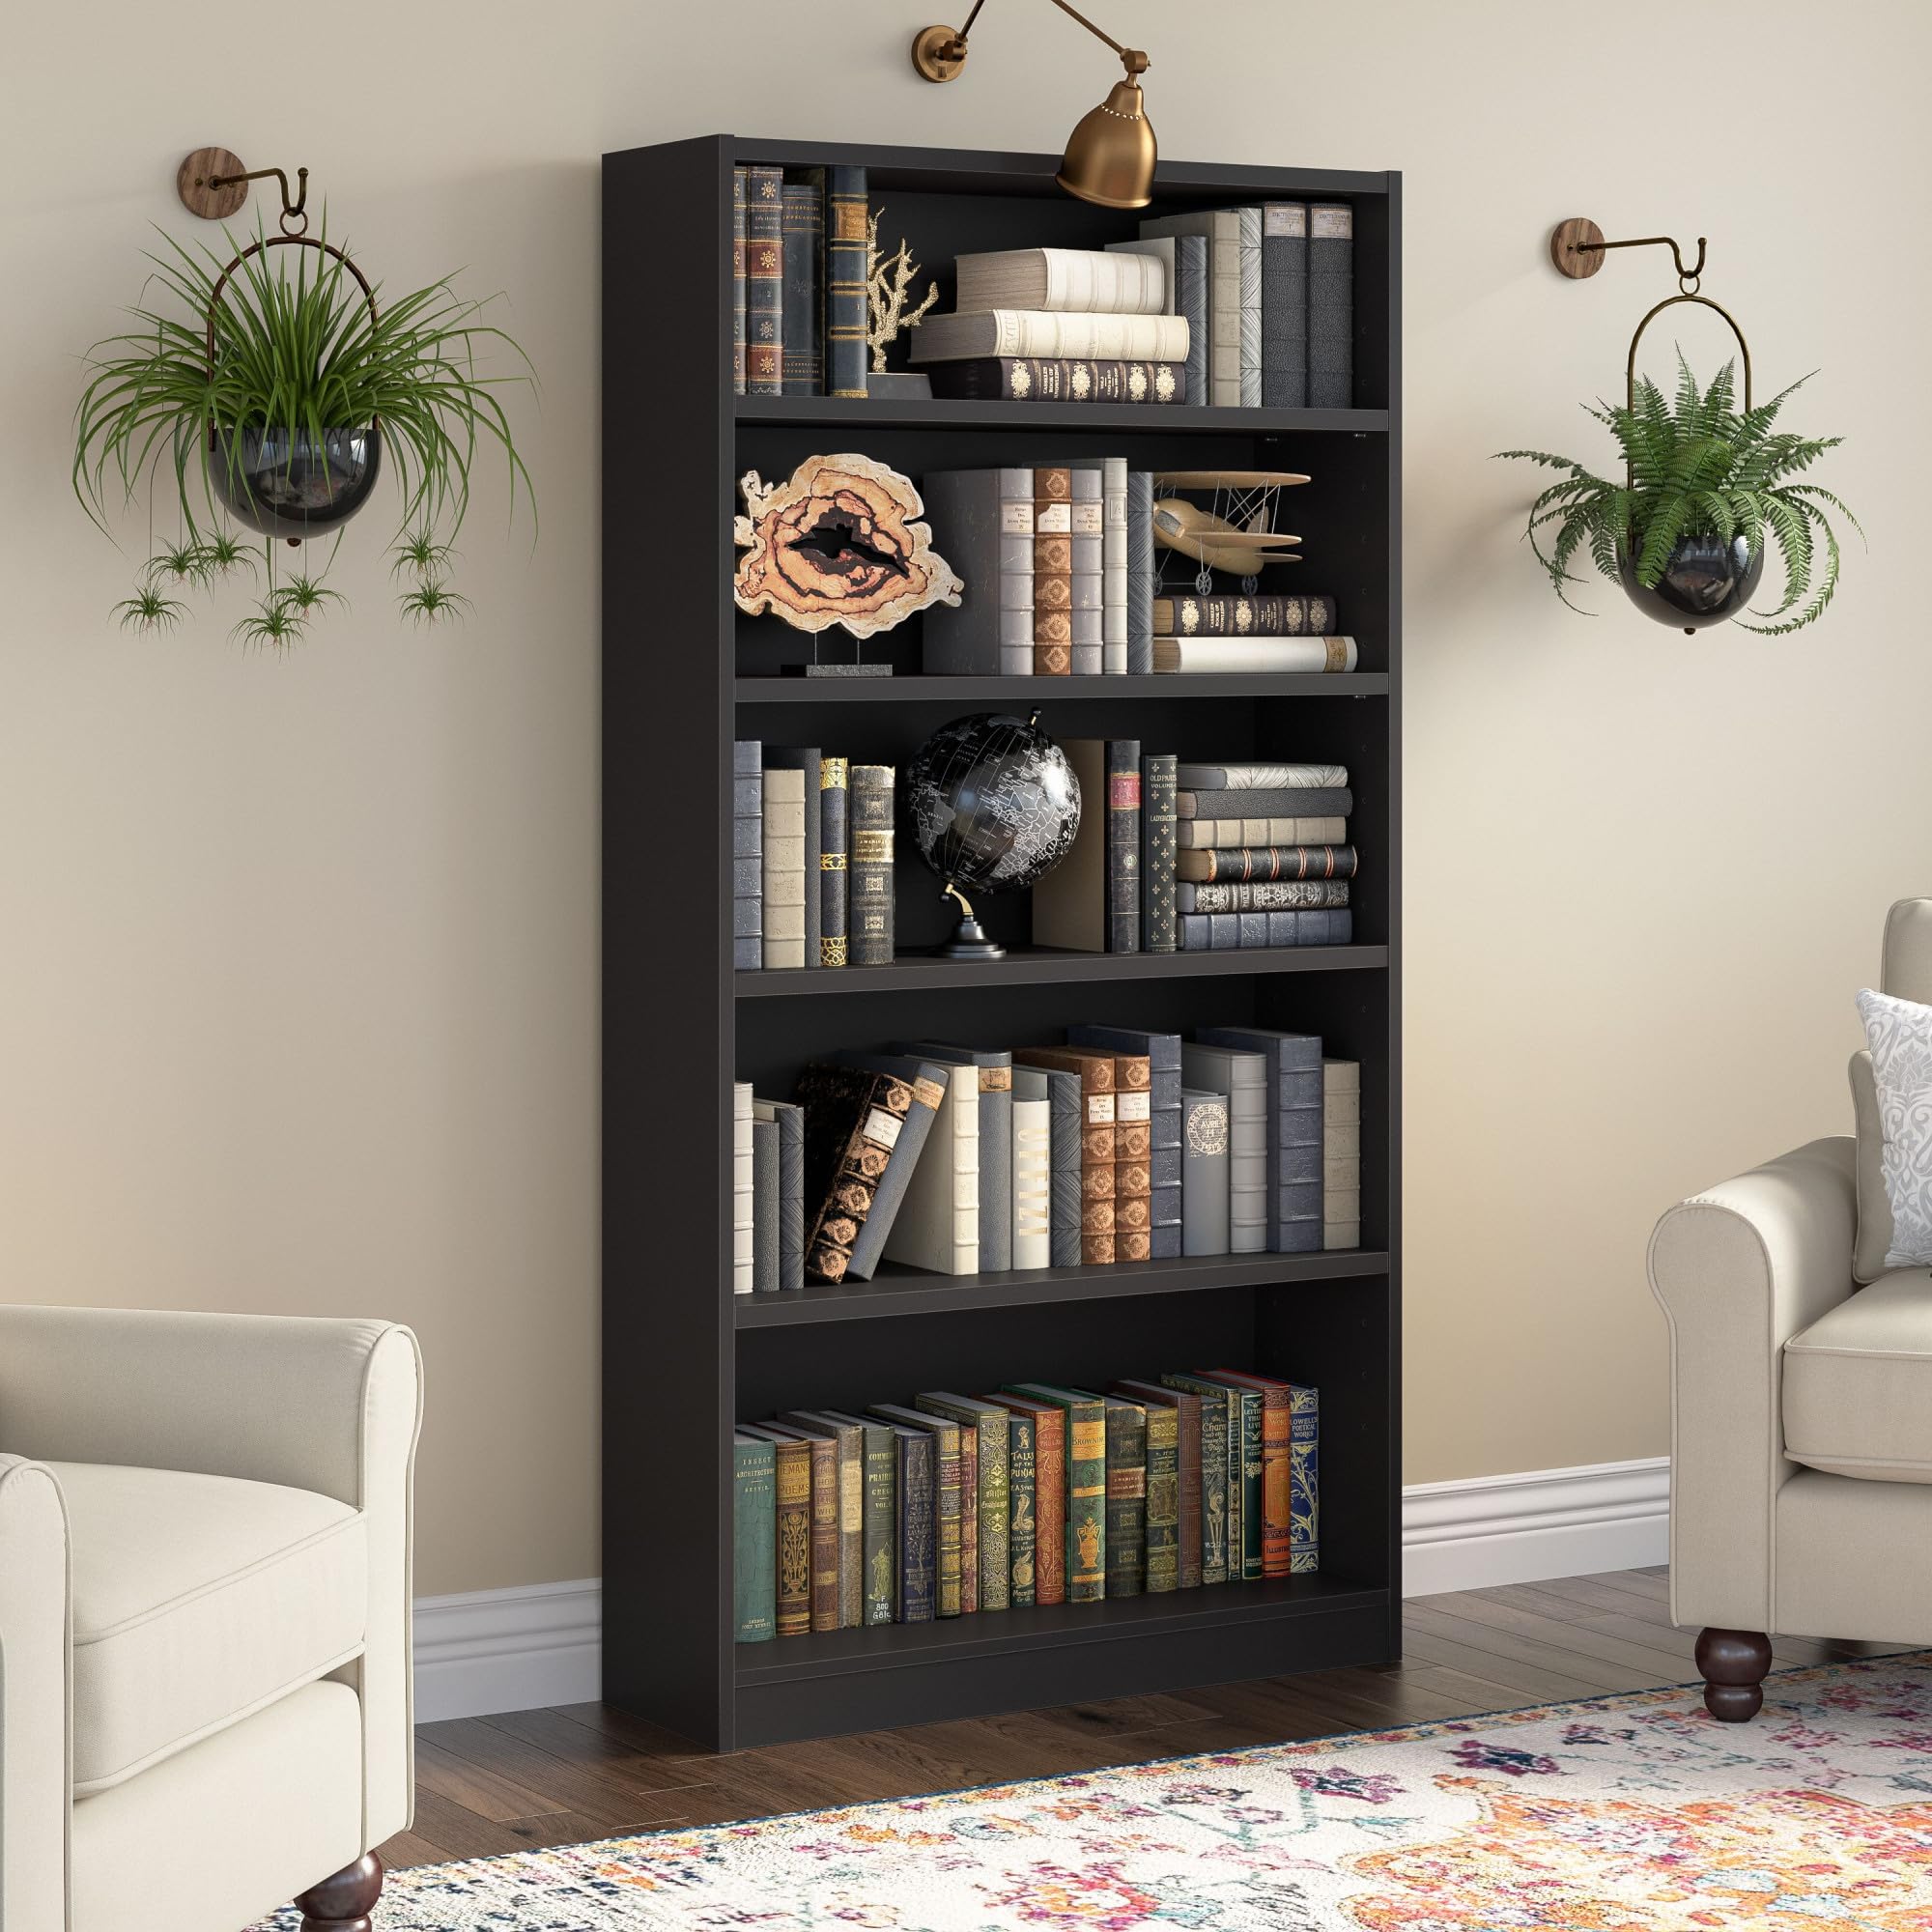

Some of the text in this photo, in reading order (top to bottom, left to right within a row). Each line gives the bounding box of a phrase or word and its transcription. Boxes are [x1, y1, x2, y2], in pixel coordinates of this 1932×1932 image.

[1018, 1128, 1047, 1236] UFFIZI
[1072, 1436, 1104, 1446] BROWNIN
[743, 1456, 771, 1465] INSECT
[868, 1452, 893, 1462] COMME
[1010, 1450, 1035, 1461] TALES
[736, 1468, 775, 1478] ARCHITECTUR
[868, 1473, 893, 1483] PRAIRI
[779, 1483, 810, 1495] POEMS
[1266, 1545, 1290, 1554] ILLUSTR
[876, 1603, 889, 1611] 800
